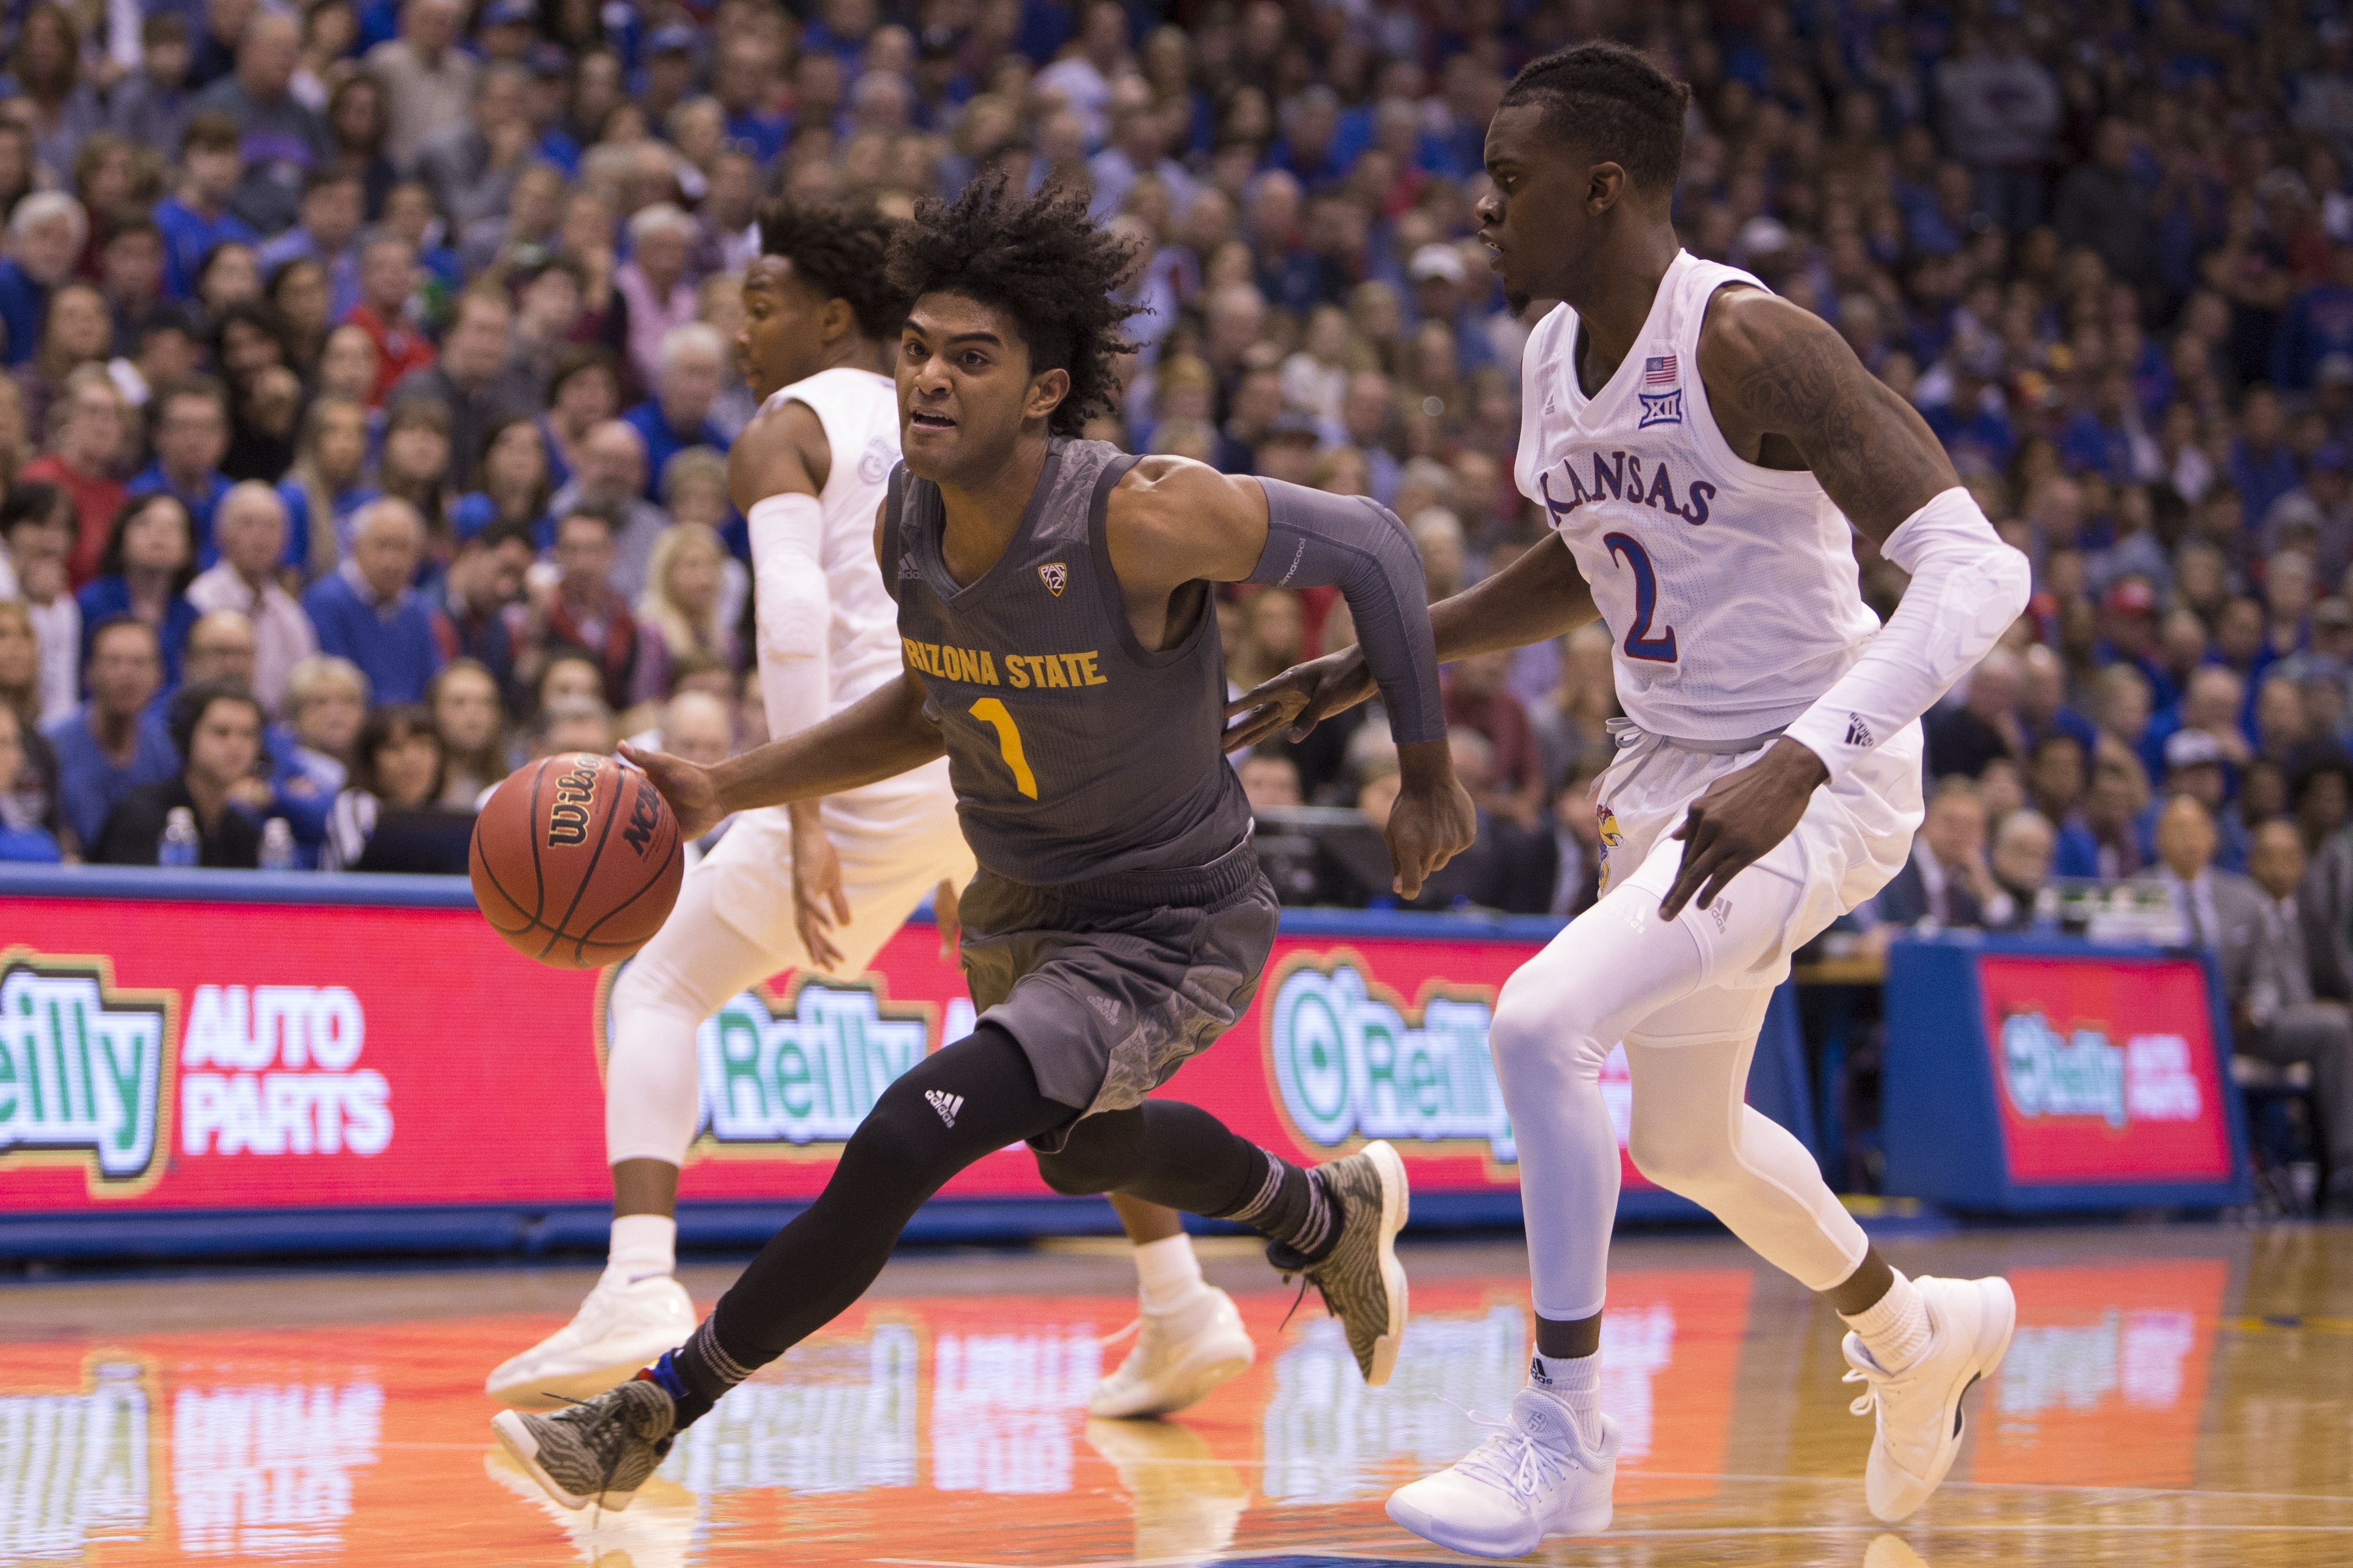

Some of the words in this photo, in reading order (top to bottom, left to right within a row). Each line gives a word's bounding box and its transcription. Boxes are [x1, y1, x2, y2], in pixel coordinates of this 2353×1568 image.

[1641, 395, 1680, 422] XII
[1040, 564, 1066, 583] PAC
[1049, 576, 1062, 589] 12
[1603, 532, 1678, 663] 2
[902, 636, 1000, 686] RIZONA
[1005, 650, 1108, 688] STATE
[968, 697, 1038, 801] 1
[181, 984, 366, 1071] AUTO
[181, 1070, 394, 1157] PARTS
[924, 1090, 955, 1128] adidas
